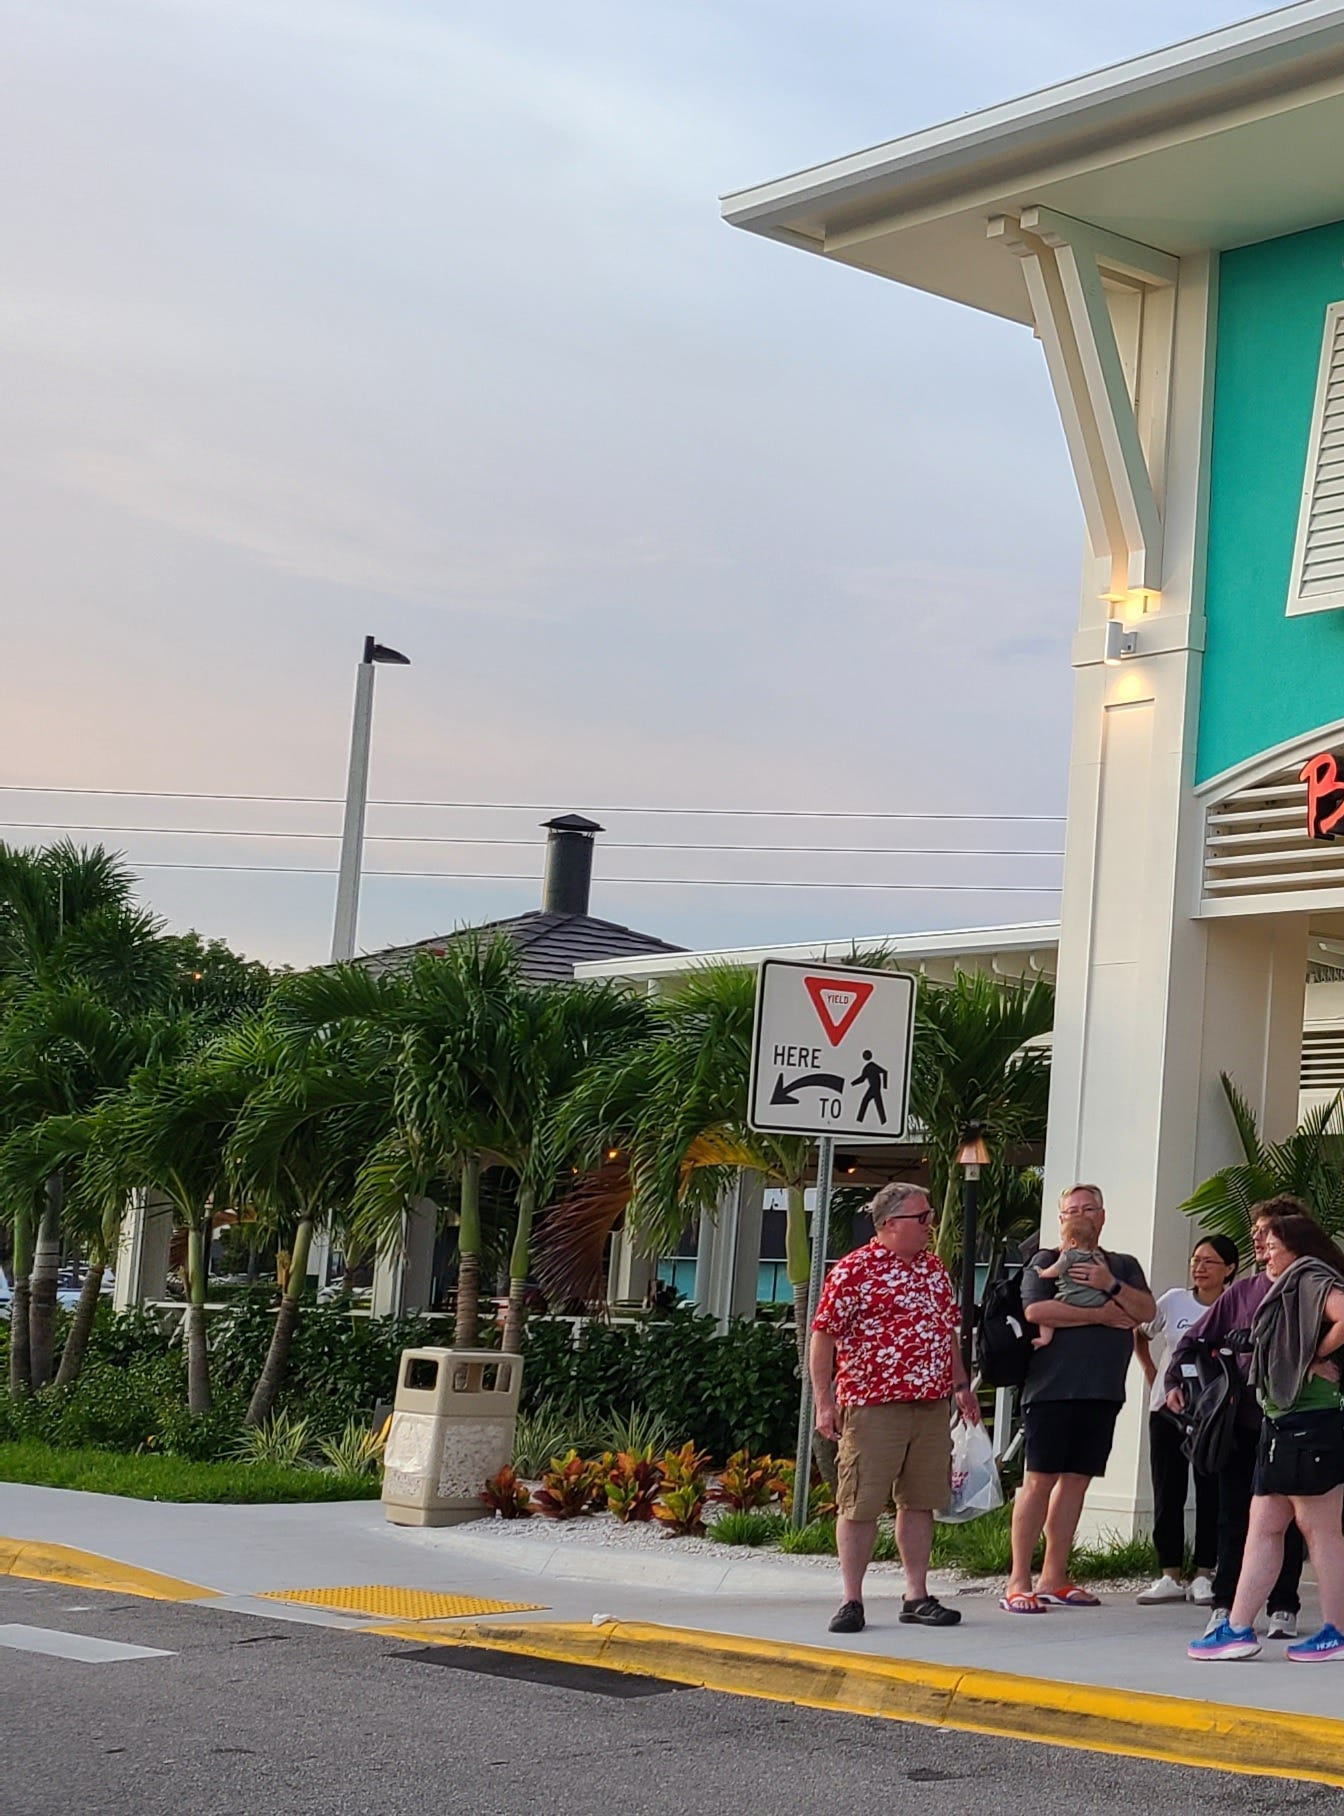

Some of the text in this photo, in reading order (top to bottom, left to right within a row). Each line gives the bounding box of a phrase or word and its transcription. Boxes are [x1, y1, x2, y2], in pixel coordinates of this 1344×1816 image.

[827, 994, 849, 1005] YIELD
[773, 1045, 822, 1069] HERE
[819, 1098, 842, 1119] TO
